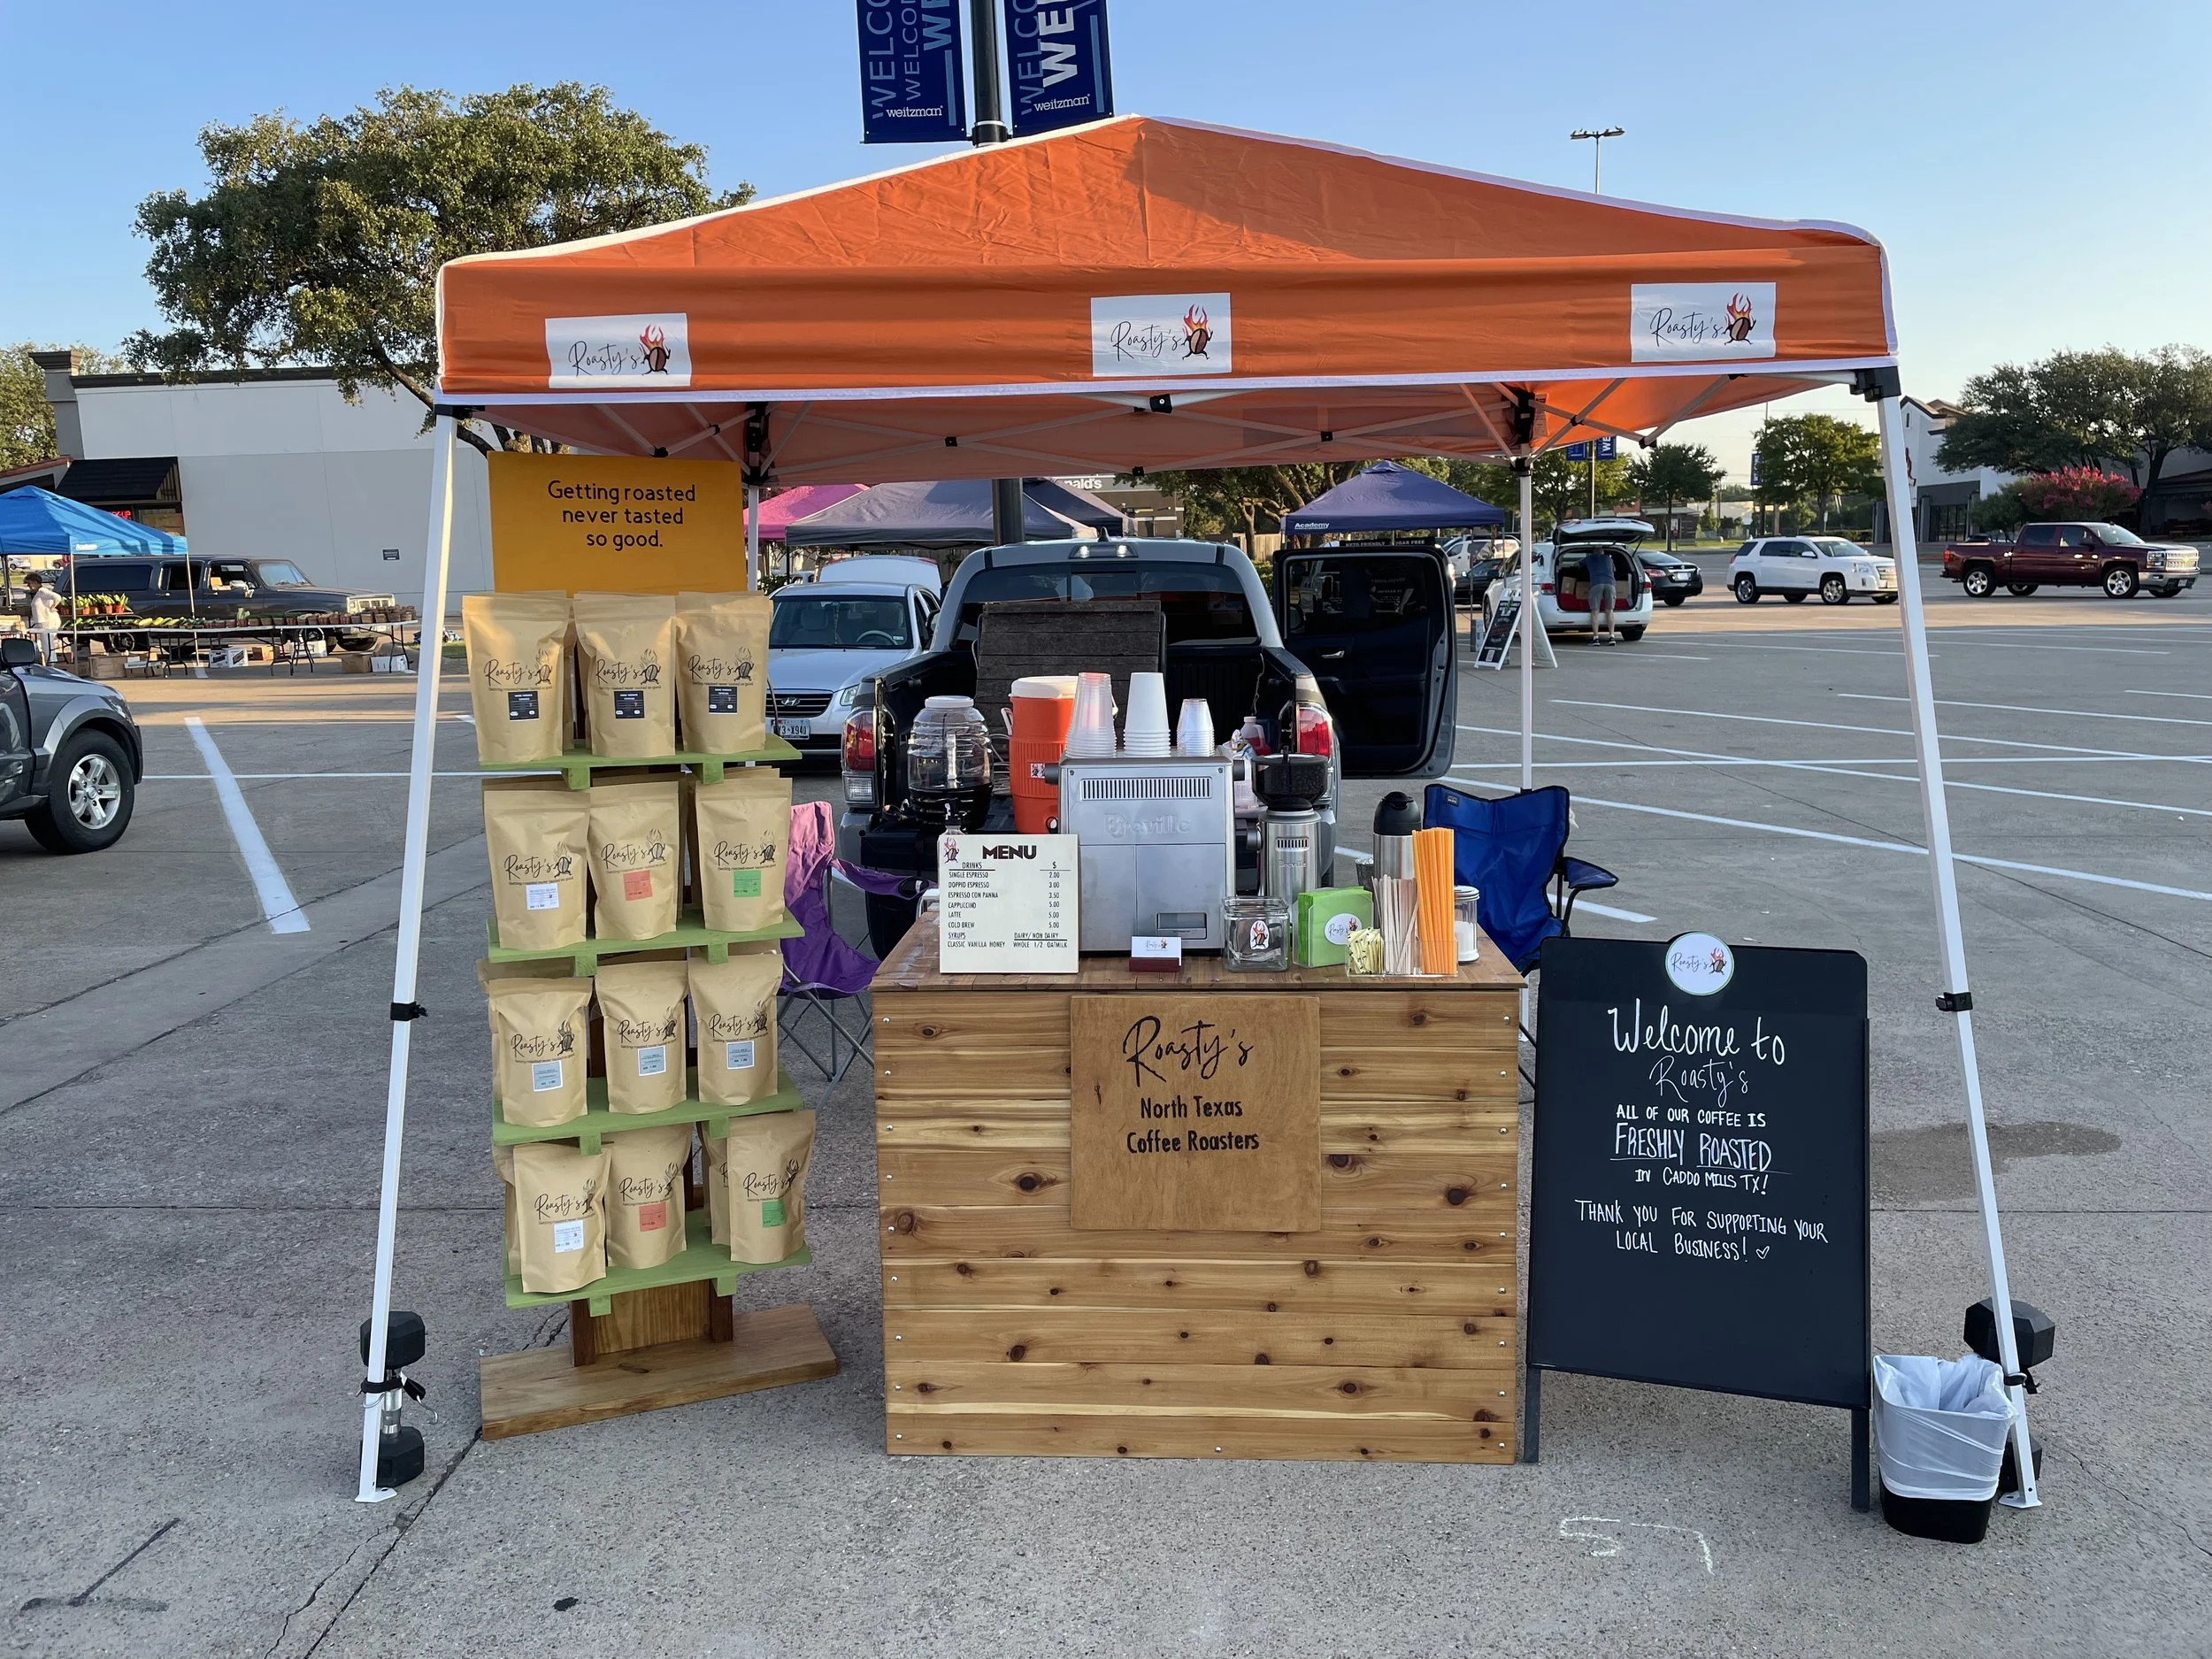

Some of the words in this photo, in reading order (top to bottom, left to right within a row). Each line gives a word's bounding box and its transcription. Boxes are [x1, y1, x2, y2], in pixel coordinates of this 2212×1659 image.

[901, 0, 921, 101] WELCO
[1037, 0, 1078, 88] WE
[866, 0, 897, 119] WELC
[1650, 307, 1723, 347] Roasty's
[1110, 320, 1182, 361] Roasty's
[568, 341, 641, 376] Roasty's
[548, 480, 619, 504] Getting
[624, 484, 696, 502] roasted
[563, 509, 618, 524] never
[624, 507, 684, 525] tasted
[586, 533, 607, 547] so
[612, 530, 664, 551] good.
[484, 658, 534, 687] Roasty's
[595, 658, 640, 686] Roasty's
[687, 654, 733, 680] Roasty's
[602, 843, 647, 870] Roasty's
[713, 841, 759, 866] Roasty's
[982, 845, 1037, 860] MENU
[504, 854, 553, 880] Roasty's
[1671, 951, 1709, 973] Roasty's
[617, 1019, 663, 1043] Roasty's
[709, 1013, 753, 1038] Roasty's
[1607, 997, 1740, 1056] Welcome
[1750, 1016, 1786, 1065] to
[511, 1033, 557, 1058] Roasty's
[1122, 1015, 1254, 1087] Roasty's
[1648, 1055, 1748, 1107] Roasty's
[1141, 1094, 1187, 1118] North
[1193, 1095, 1243, 1117] Texas
[1616, 1104, 1639, 1120] ALL
[1646, 1106, 1659, 1120] OF
[1667, 1108, 1689, 1123] OUR
[1697, 1109, 1741, 1127] COFFEE
[1747, 1112, 1766, 1127] IS
[1126, 1129, 1181, 1153] Coffee
[1187, 1130, 1259, 1151] Roasters
[1615, 1122, 1684, 1165] FRESHLY
[1699, 1133, 1771, 1171] ROASTED
[619, 1177, 664, 1202] Roasty's
[1635, 1169, 1651, 1182] IN
[1663, 1166, 1700, 1186] CADDO
[1705, 1172, 1737, 1188] MILLS
[1740, 1174, 1769, 1194] TX!
[534, 1194, 582, 1220] Roasty's
[1574, 1199, 1624, 1224] THANK
[1632, 1205, 1657, 1227] YOU
[1671, 1206, 1697, 1228] FOR
[1706, 1210, 1786, 1235] SUPPORTING
[1793, 1219, 1829, 1243] YOUR
[1616, 1230, 1658, 1254] LOCAL
[1674, 1232, 1748, 1263] BUSINESS!
